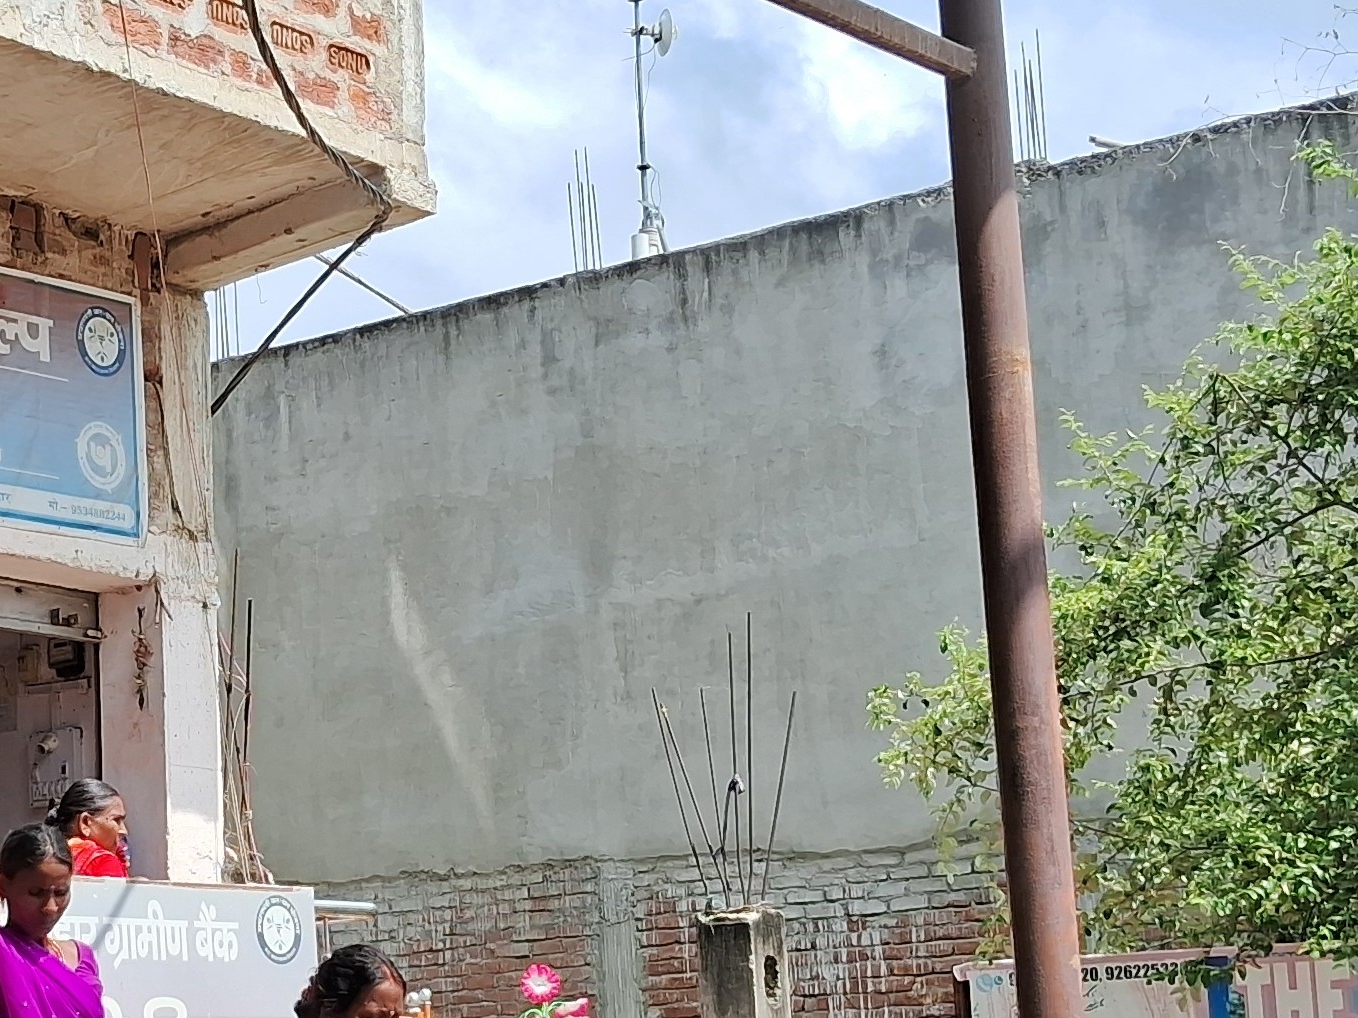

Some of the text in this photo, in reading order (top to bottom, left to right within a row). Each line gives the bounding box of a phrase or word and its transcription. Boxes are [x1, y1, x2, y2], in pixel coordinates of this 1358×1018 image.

[328, 46, 367, 75] SONU
[103, 899, 189, 970] ग्रामीण
[194, 900, 240, 963] बैंक
